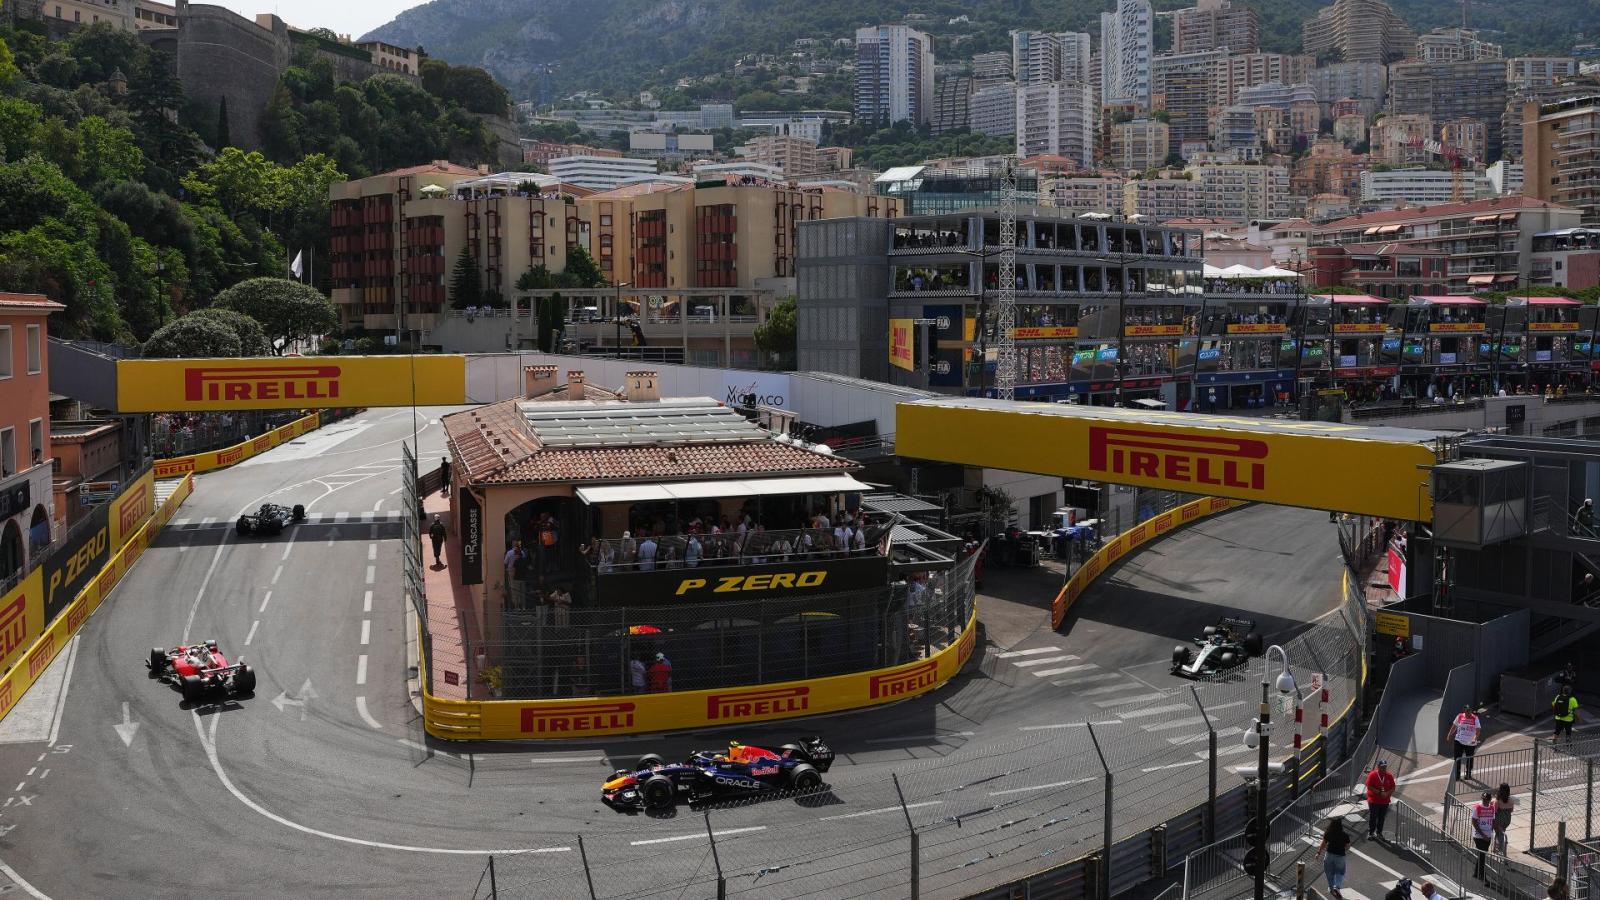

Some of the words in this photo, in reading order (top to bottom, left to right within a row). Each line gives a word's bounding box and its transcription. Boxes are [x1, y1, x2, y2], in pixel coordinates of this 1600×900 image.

[185, 366, 342, 401] PIRELLI
[726, 393, 784, 406] MOACO
[254, 435, 272, 451] PIRELLI
[279, 425, 294, 440] PIRELLI
[217, 447, 243, 464] PIRELLI
[1089, 426, 1269, 490] PIRELLI
[119, 483, 147, 541] PIRELLI
[1182, 503, 1200, 520] PIRELLI
[1210, 498, 1230, 513] PIRELLI
[464, 508, 478, 556] RASCASSE
[1130, 526, 1146, 547] PIRELLI
[1155, 514, 1172, 533] PIRELLI
[48, 567, 62, 605] P
[65, 526, 107, 589] ZERO
[124, 539, 139, 569] PIRELLI
[1108, 540, 1121, 562] PIRELLI
[99, 564, 116, 598] PIRELLI
[675, 578, 707, 595] P
[713, 571, 828, 593] ZERO
[67, 595, 88, 635] PIRELLI
[28, 633, 55, 680] PIRELLI
[958, 630, 974, 665] PIRELLI
[870, 660, 938, 700] PIRELLI
[520, 702, 636, 733] PIRELLI
[707, 686, 810, 720] PIRELLI
[715, 777, 760, 789] ORACLE
